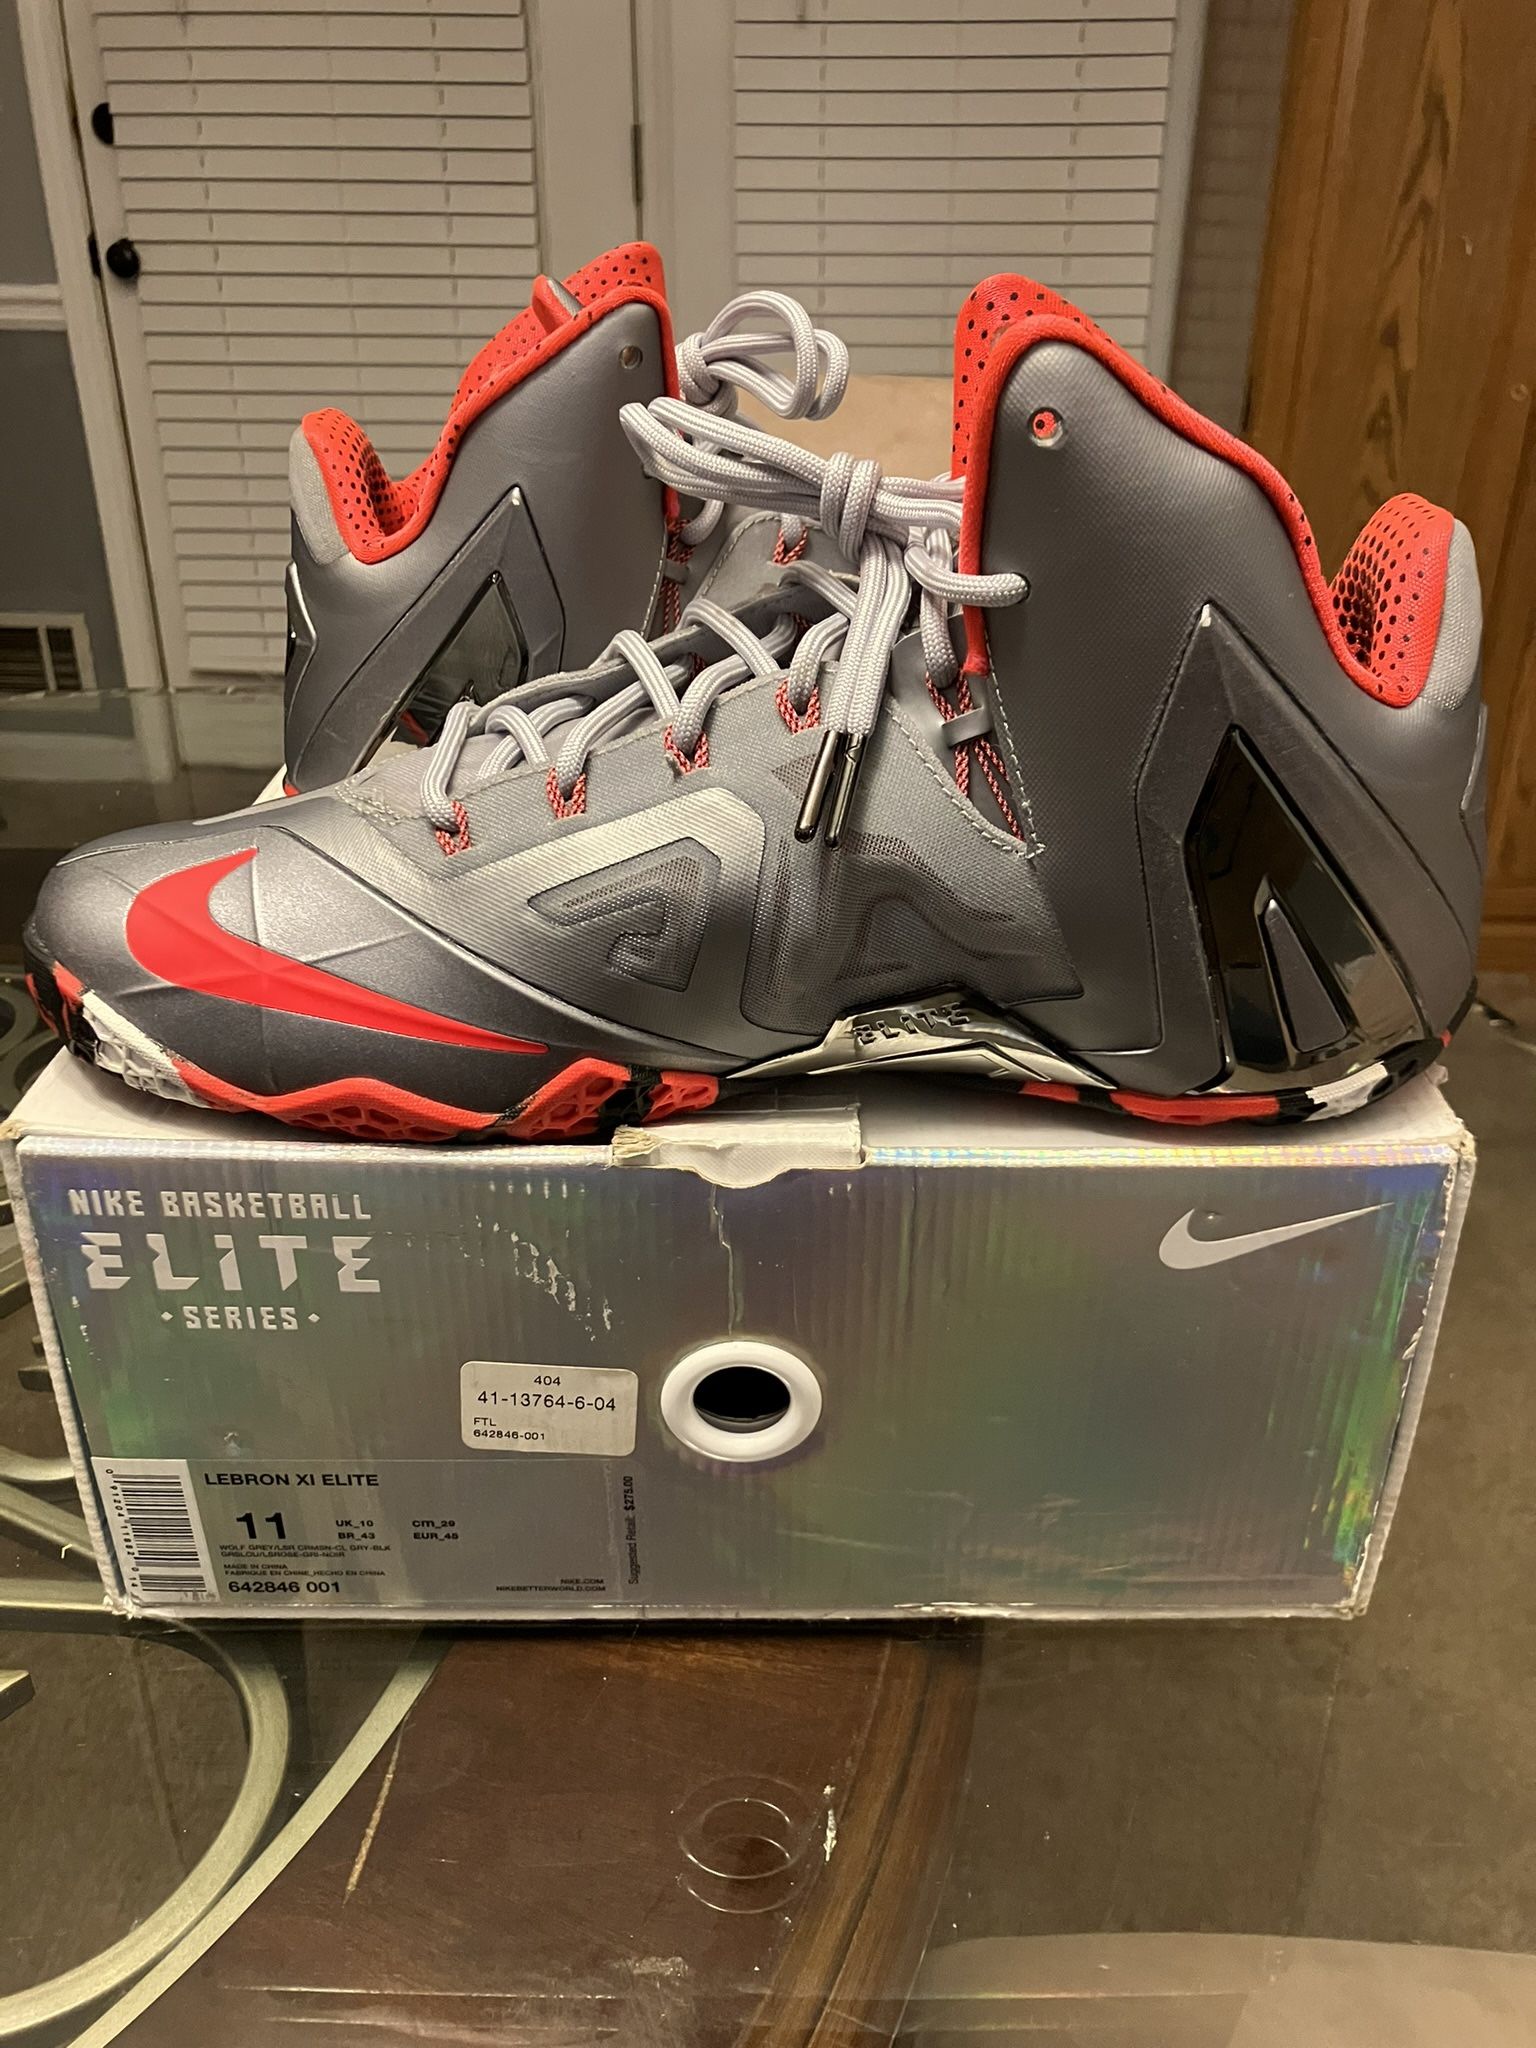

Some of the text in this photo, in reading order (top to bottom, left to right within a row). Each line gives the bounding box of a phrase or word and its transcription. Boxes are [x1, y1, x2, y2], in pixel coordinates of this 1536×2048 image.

[853, 1002, 970, 1045] ELITE
[68, 1189, 372, 1220] NIKE BASKETBALL
[80, 1231, 381, 1293] ELITE
[182, 1305, 299, 1331] SERIES
[533, 1375, 561, 1386] 404
[477, 1390, 616, 1411] 41-13764-6-04
[473, 1417, 497, 1427] FTL
[473, 1429, 545, 1440] 642846-001
[204, 1473, 379, 1486] LEBRON XI ELITE
[623, 1475, 635, 1511] $275.00
[236, 1512, 287, 1539] 11
[628, 1543, 641, 1584] Suggested
[228, 1580, 341, 1593] 642846 001
